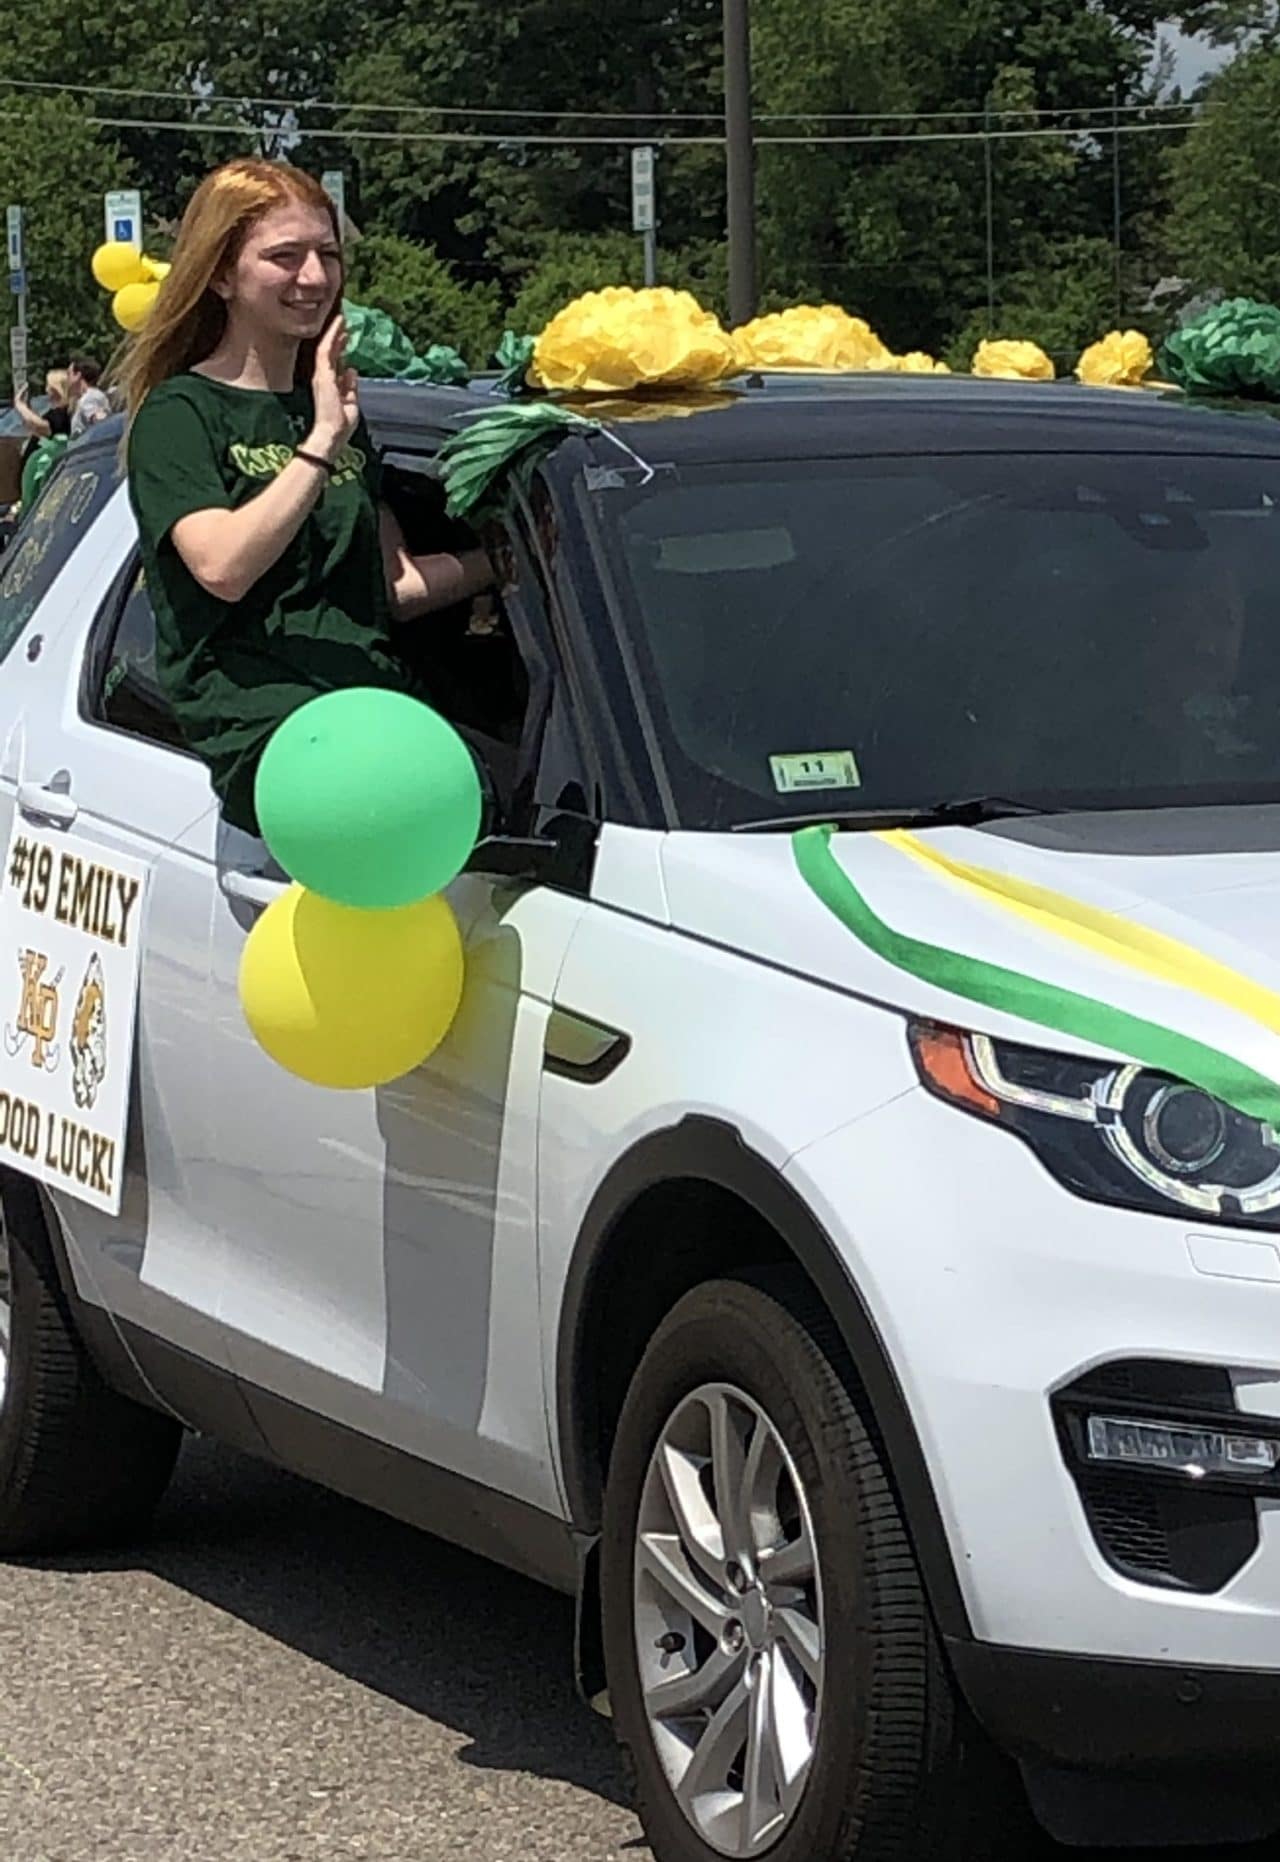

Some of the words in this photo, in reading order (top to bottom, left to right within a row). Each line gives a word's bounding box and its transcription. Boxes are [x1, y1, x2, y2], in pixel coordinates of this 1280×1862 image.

[800, 759, 824, 773] 11
[9, 836, 53, 911] #19
[55, 852, 140, 947] EMILY
[0, 1092, 40, 1159] OOD
[45, 1112, 116, 1196] LUCK!
